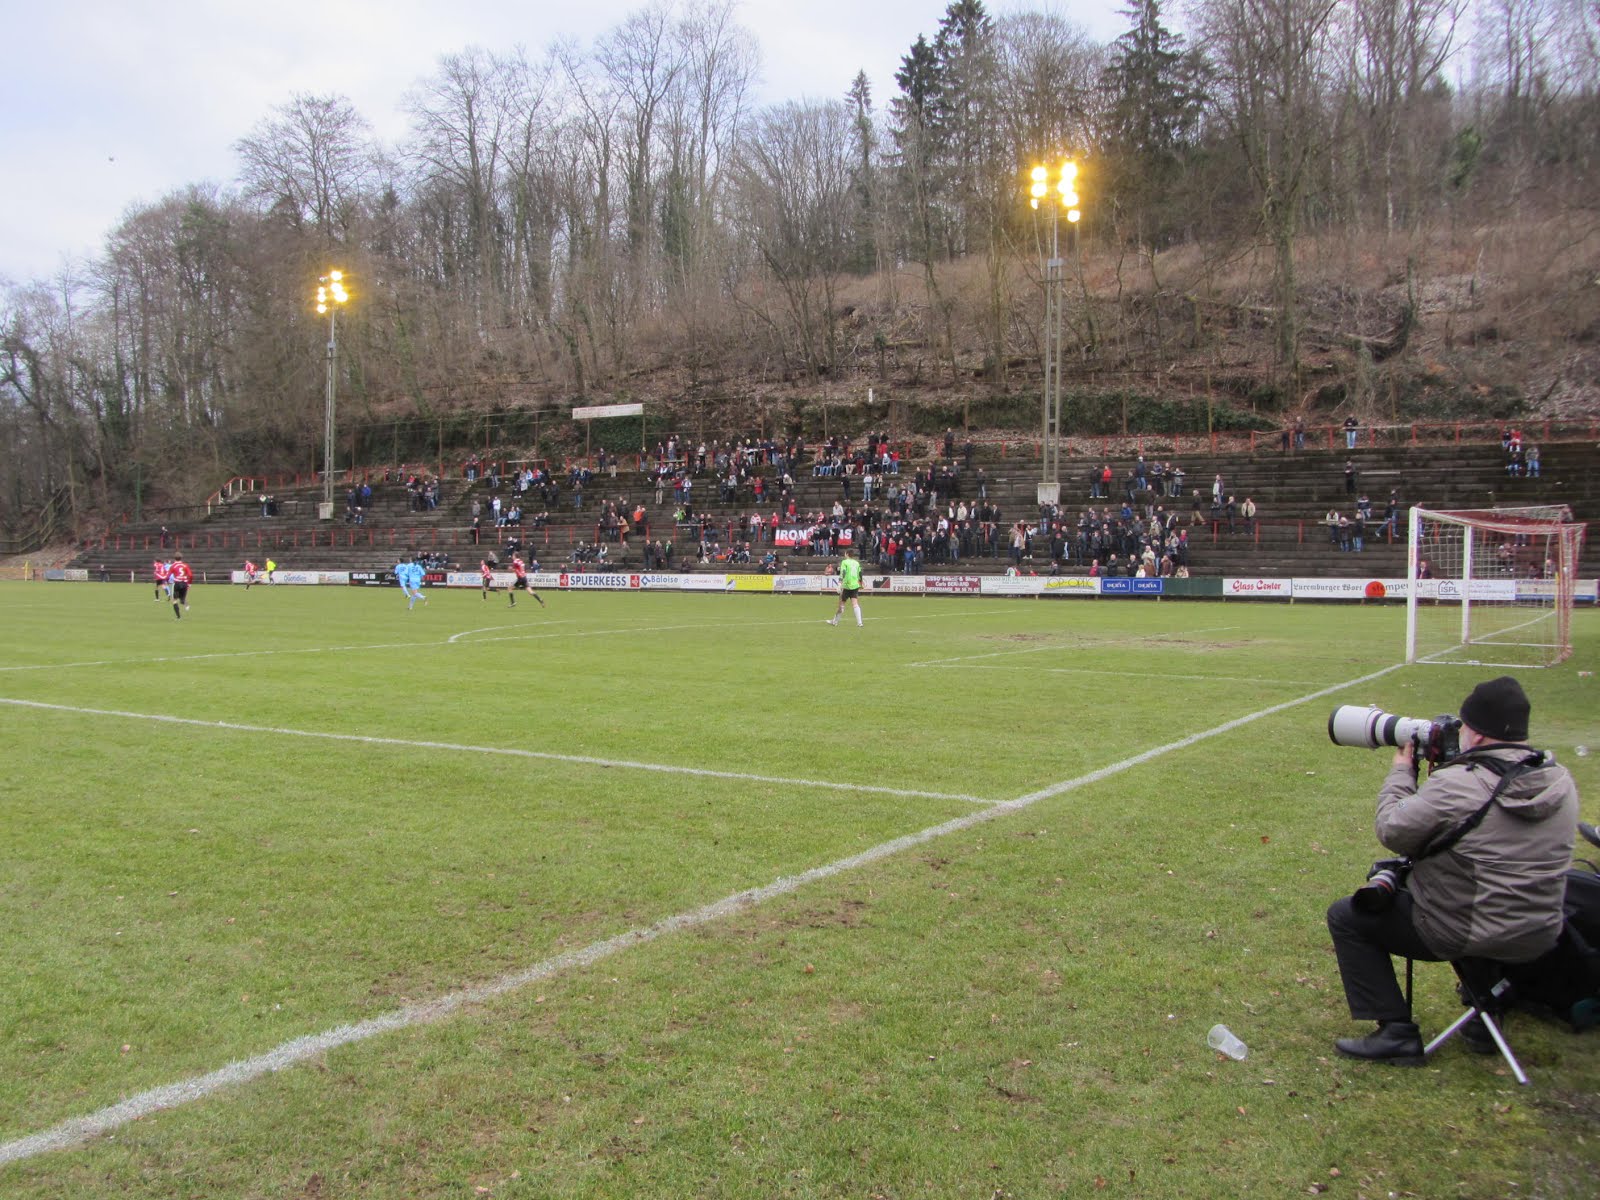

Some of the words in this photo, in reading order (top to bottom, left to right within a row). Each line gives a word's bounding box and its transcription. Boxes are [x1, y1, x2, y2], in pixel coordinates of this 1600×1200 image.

[776, 529, 807, 540] IRON
[178, 567, 185, 577] 5
[570, 575, 627, 587] SPUERKEESS
[1232, 580, 1254, 592] Glass
[1256, 580, 1282, 590] Center
[1342, 583, 1362, 591] Wort
